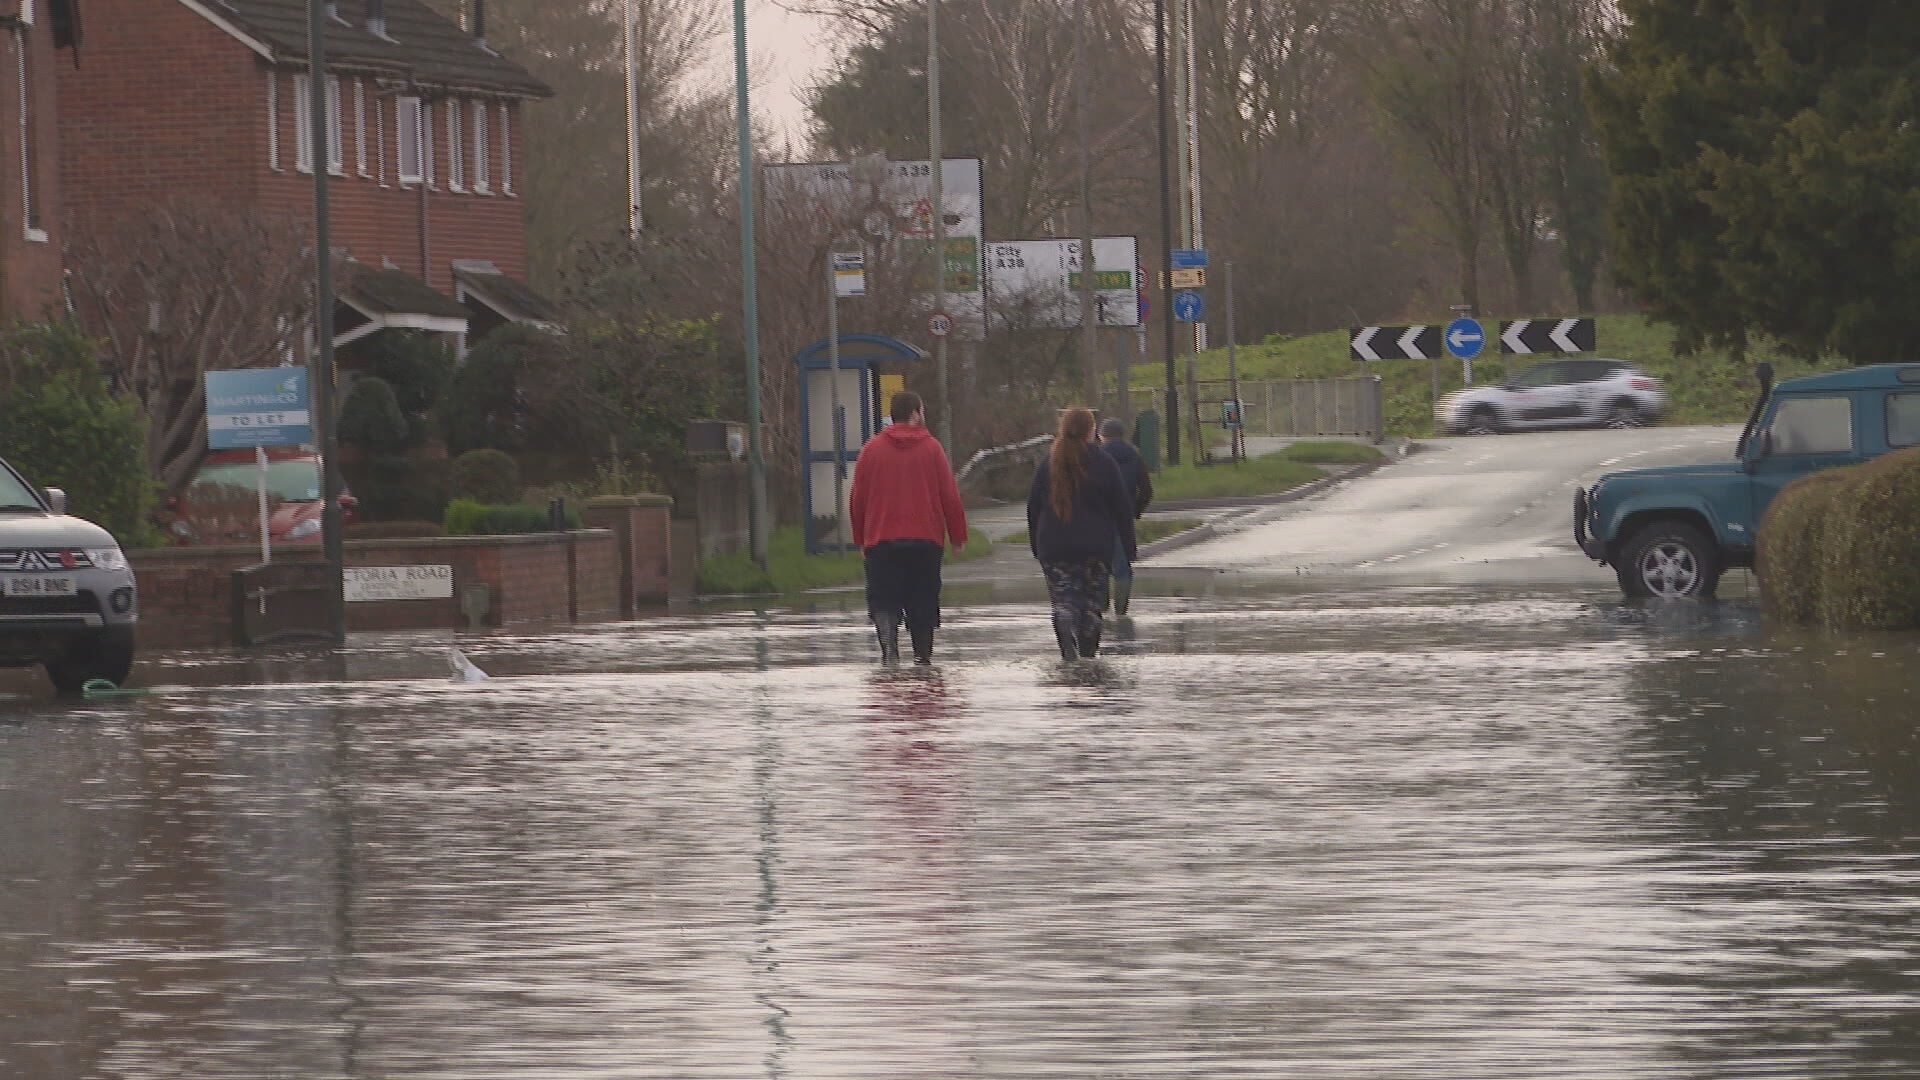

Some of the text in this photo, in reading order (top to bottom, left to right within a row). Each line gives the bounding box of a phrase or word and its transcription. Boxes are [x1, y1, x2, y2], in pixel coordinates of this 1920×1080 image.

[996, 245, 1022, 258] City
[232, 414, 285, 426] TO LET
[407, 567, 450, 580] ROAD
